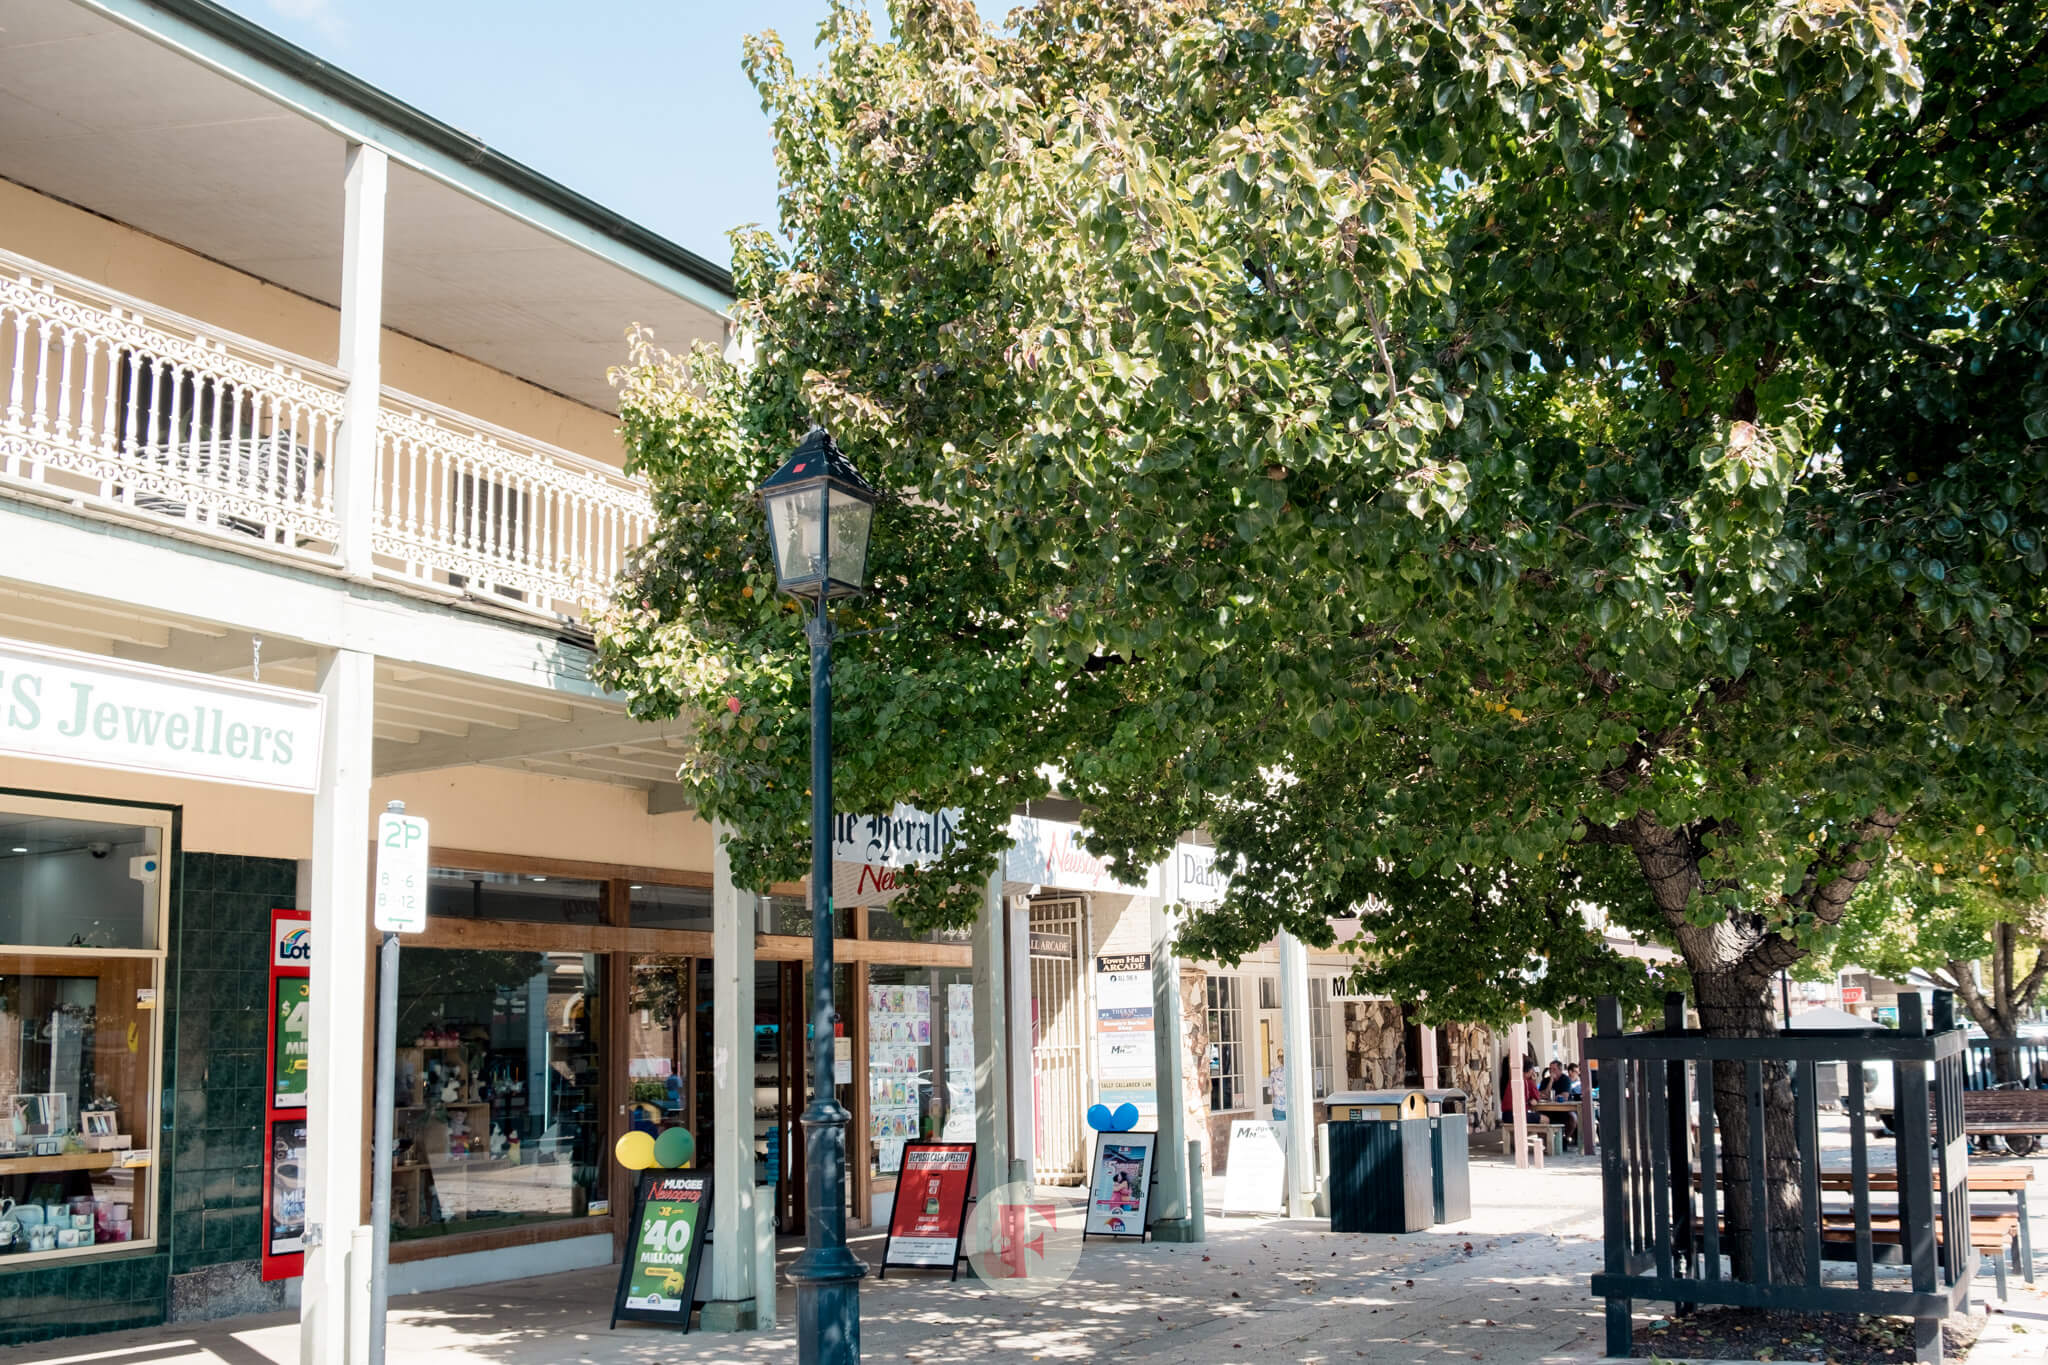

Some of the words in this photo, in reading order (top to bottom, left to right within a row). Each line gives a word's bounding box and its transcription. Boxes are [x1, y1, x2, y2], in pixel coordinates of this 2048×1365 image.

[58, 682, 294, 766] Jewellers
[385, 821, 422, 849] 2P
[866, 812, 955, 862] Herald
[279, 940, 311, 960] Lot
[1041, 940, 1069, 952] ARCADE
[1101, 957, 1125, 965] Town
[1126, 955, 1146, 964] Hall
[1103, 962, 1145, 972] ARCADE
[281, 1000, 309, 1040] $4
[909, 1152, 930, 1162] DEPOSIT
[930, 1153, 943, 1162] CASH
[944, 1153, 968, 1163] DIRECTLY
[648, 1181, 702, 1203] Newsagency
[664, 1179, 704, 1190] MUDGEE
[643, 1219, 691, 1252] $40
[640, 1252, 684, 1265] MILLION
